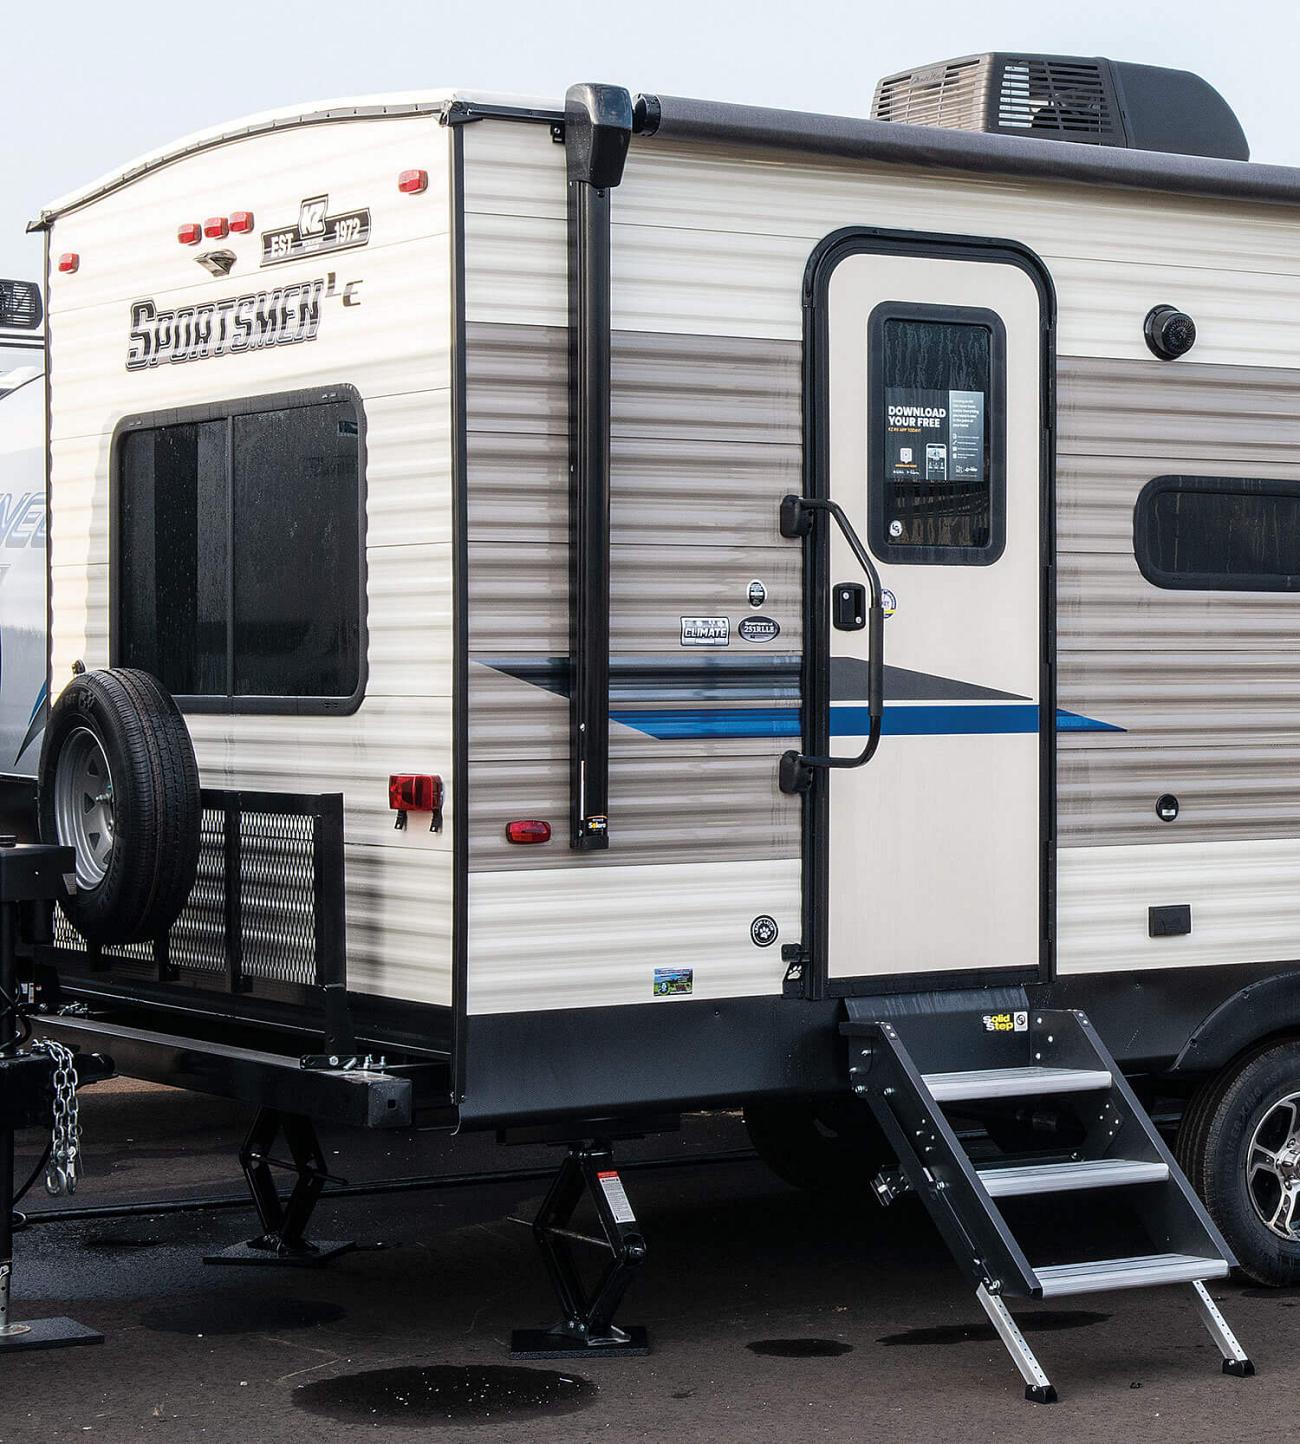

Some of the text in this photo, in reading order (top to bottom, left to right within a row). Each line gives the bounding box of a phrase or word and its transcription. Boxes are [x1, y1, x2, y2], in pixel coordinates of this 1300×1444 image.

[302, 201, 325, 235] KZ
[270, 217, 361, 258] EST. 1972
[888, 405, 947, 418] DOWNLOAD
[888, 415, 941, 428] YOUR FREE
[684, 627, 727, 638] CLIMATE
[982, 1014, 1010, 1024] Solid
[986, 1022, 1014, 1031] Step
